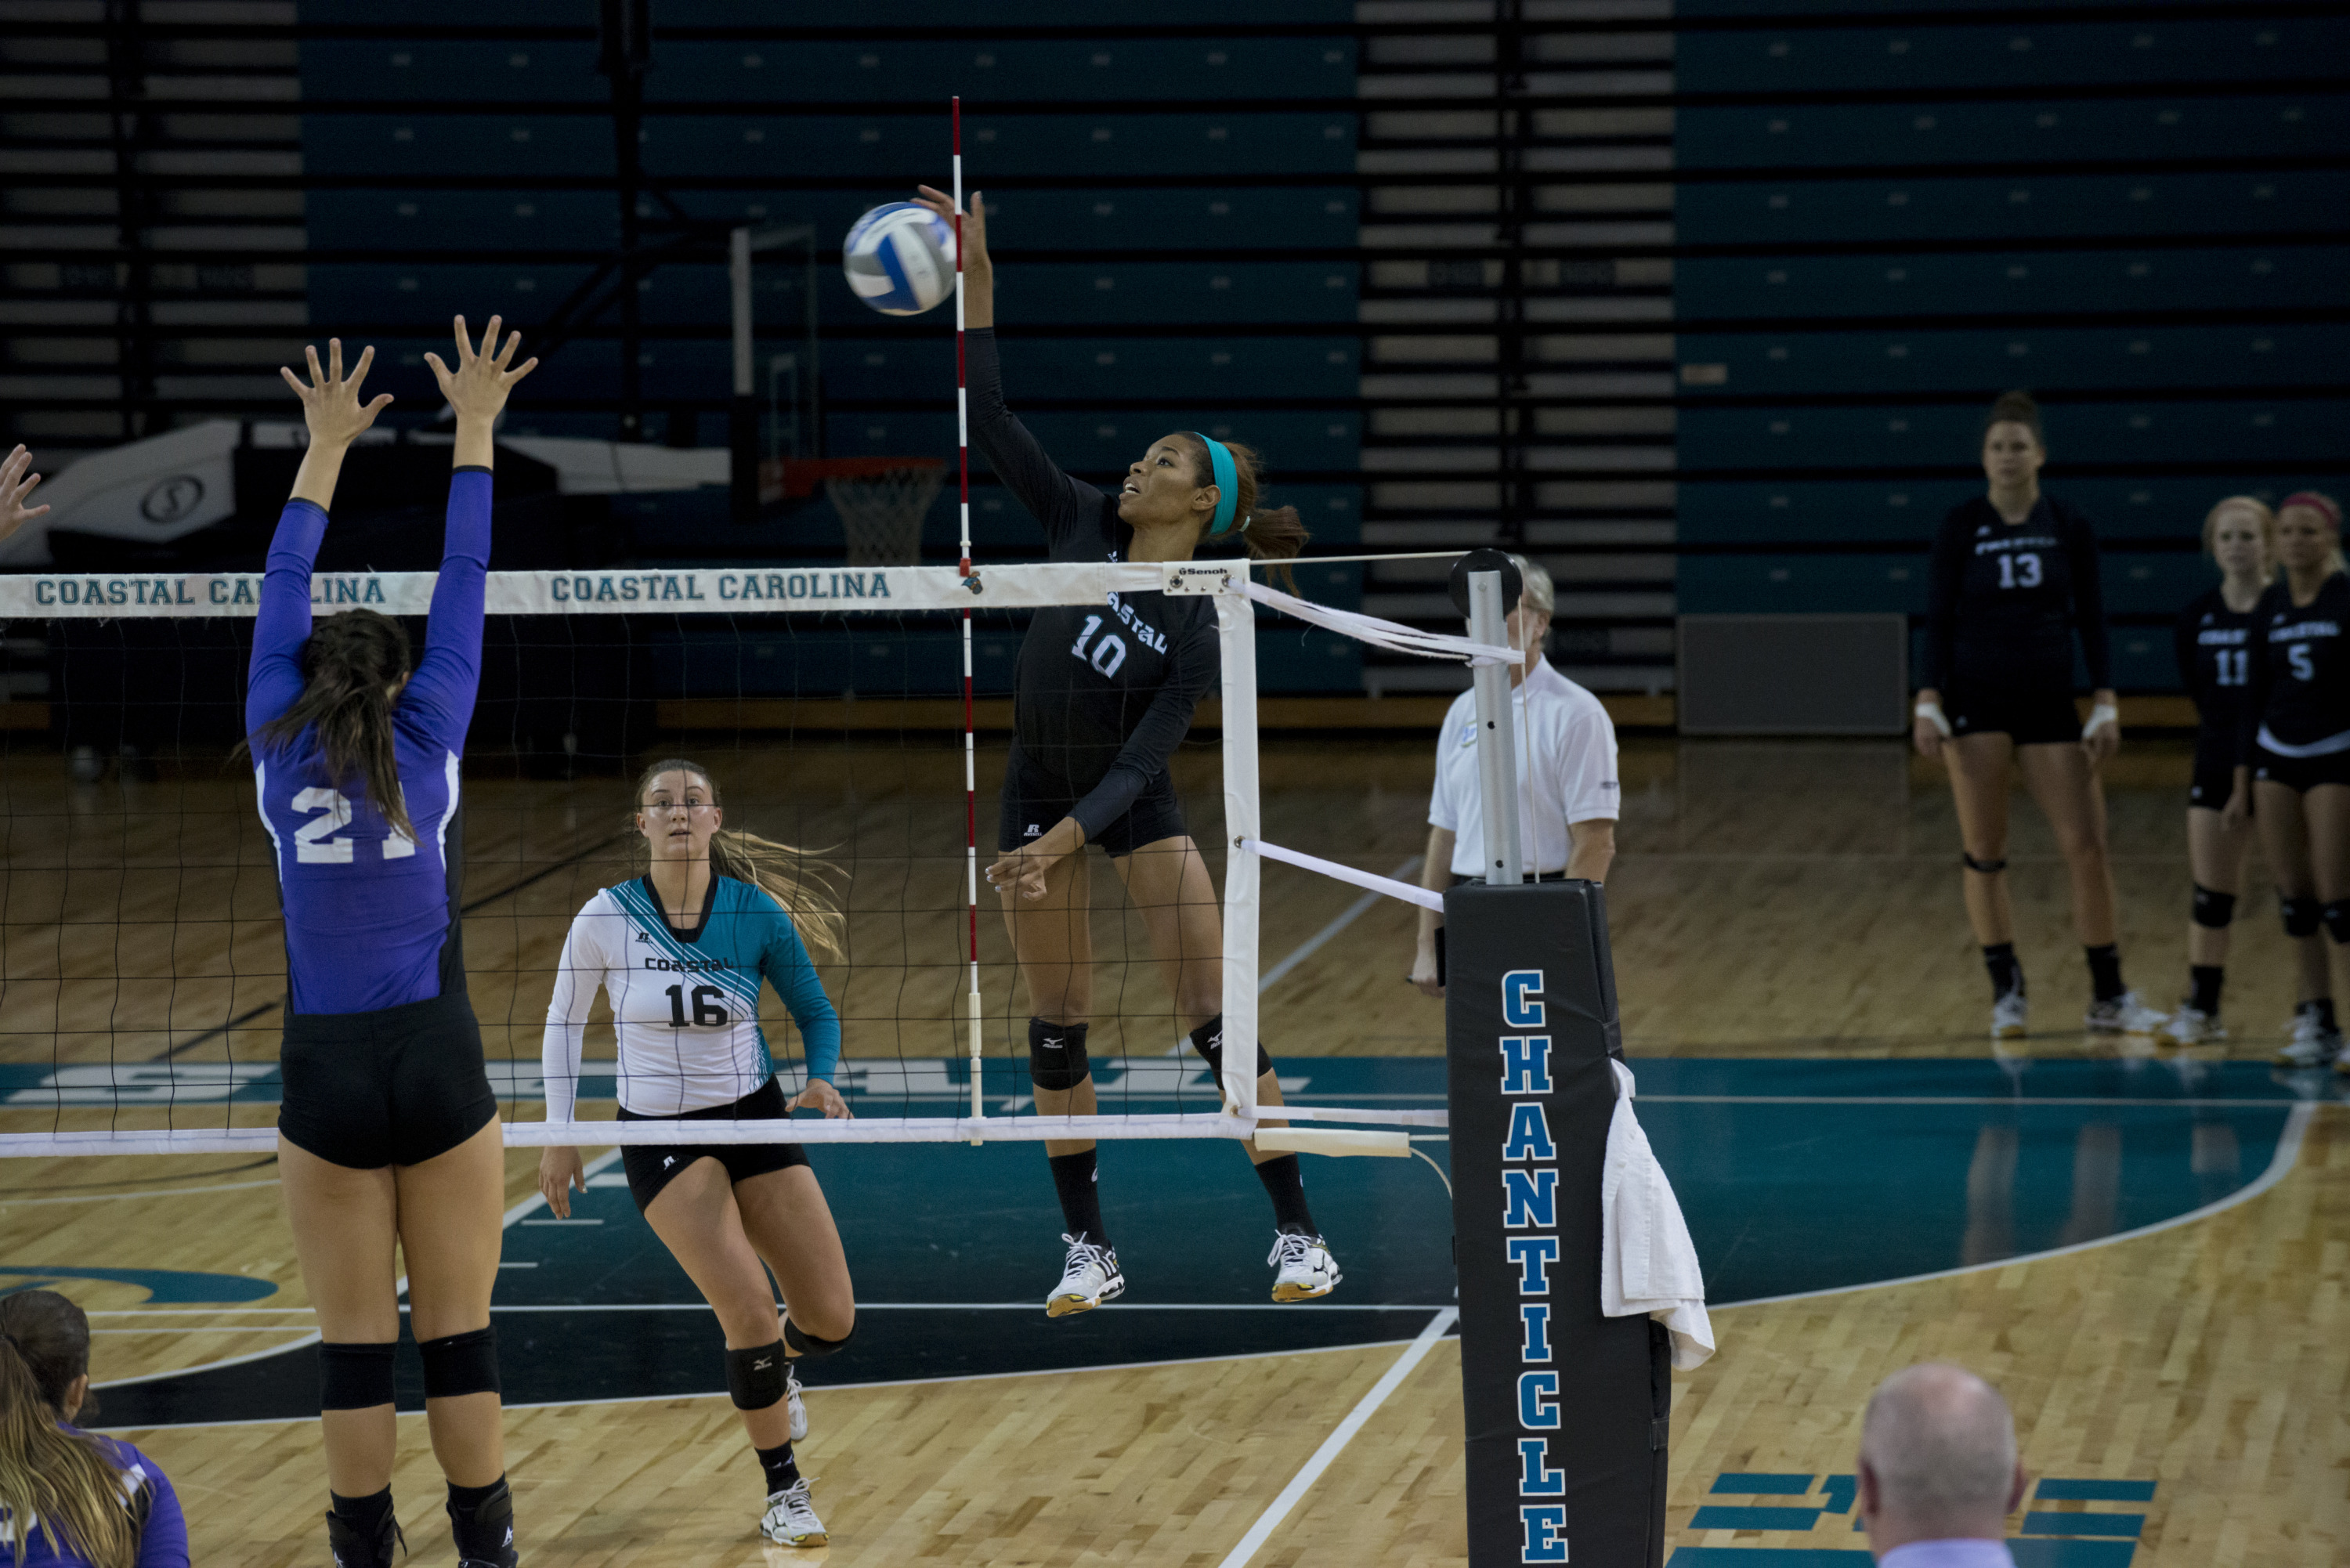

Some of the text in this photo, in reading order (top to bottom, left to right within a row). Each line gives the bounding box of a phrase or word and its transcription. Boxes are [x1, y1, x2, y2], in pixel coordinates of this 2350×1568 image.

[551, 572, 891, 602] COASTAL CAROLINA
[1998, 553, 2043, 588] 13
[35, 576, 386, 606] COASTAL CAINA
[1107, 592, 1167, 655] ASTAL
[1072, 614, 1126, 678] 10
[2288, 643, 2314, 681] 5
[2214, 649, 2248, 687] 11
[665, 985, 728, 1027] 16
[1499, 970, 1568, 1564] CHANTICLE
